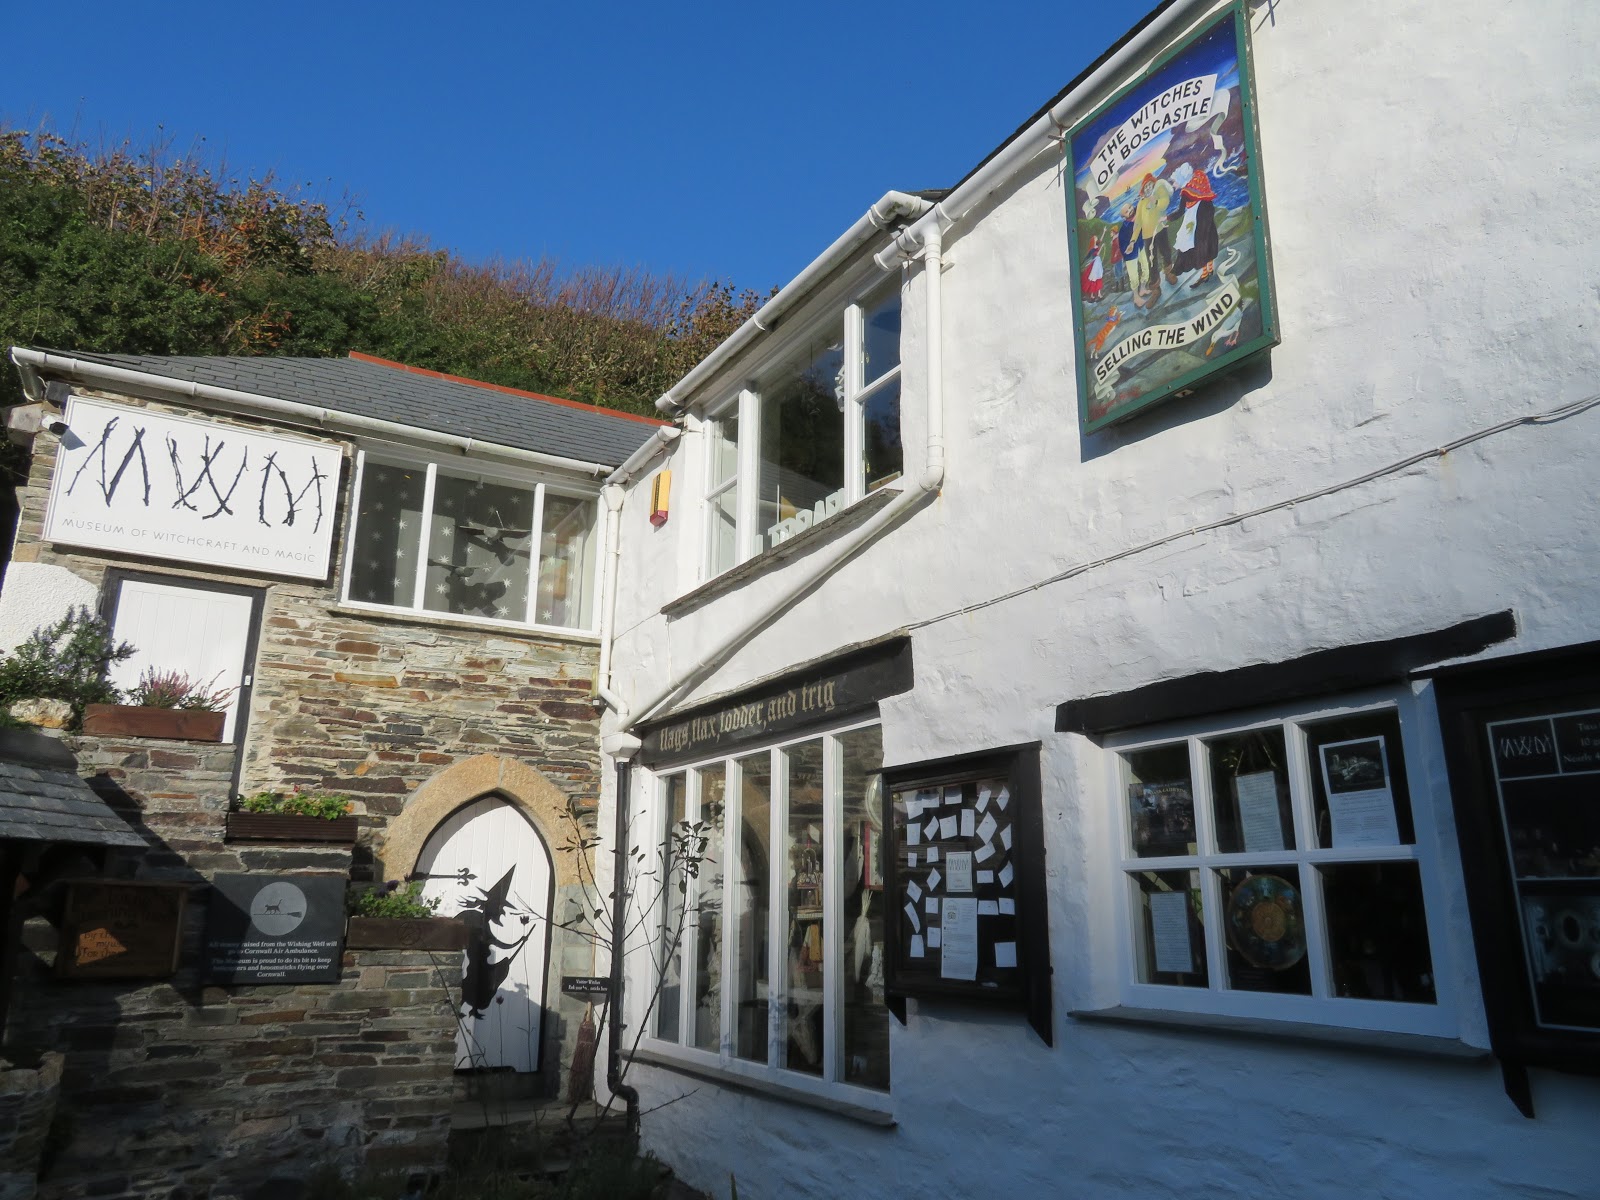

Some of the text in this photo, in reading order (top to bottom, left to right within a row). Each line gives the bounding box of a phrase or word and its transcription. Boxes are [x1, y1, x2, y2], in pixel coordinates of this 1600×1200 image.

[1097, 79, 1203, 163] THE WITCHES
[1097, 97, 1211, 186] OF BOSCASTLE
[1097, 293, 1233, 381] SELLING THE WIND
[62, 518, 316, 563] MUSEUM OF WITCHCRAFT AND MAGIC
[768, 689, 797, 721] and
